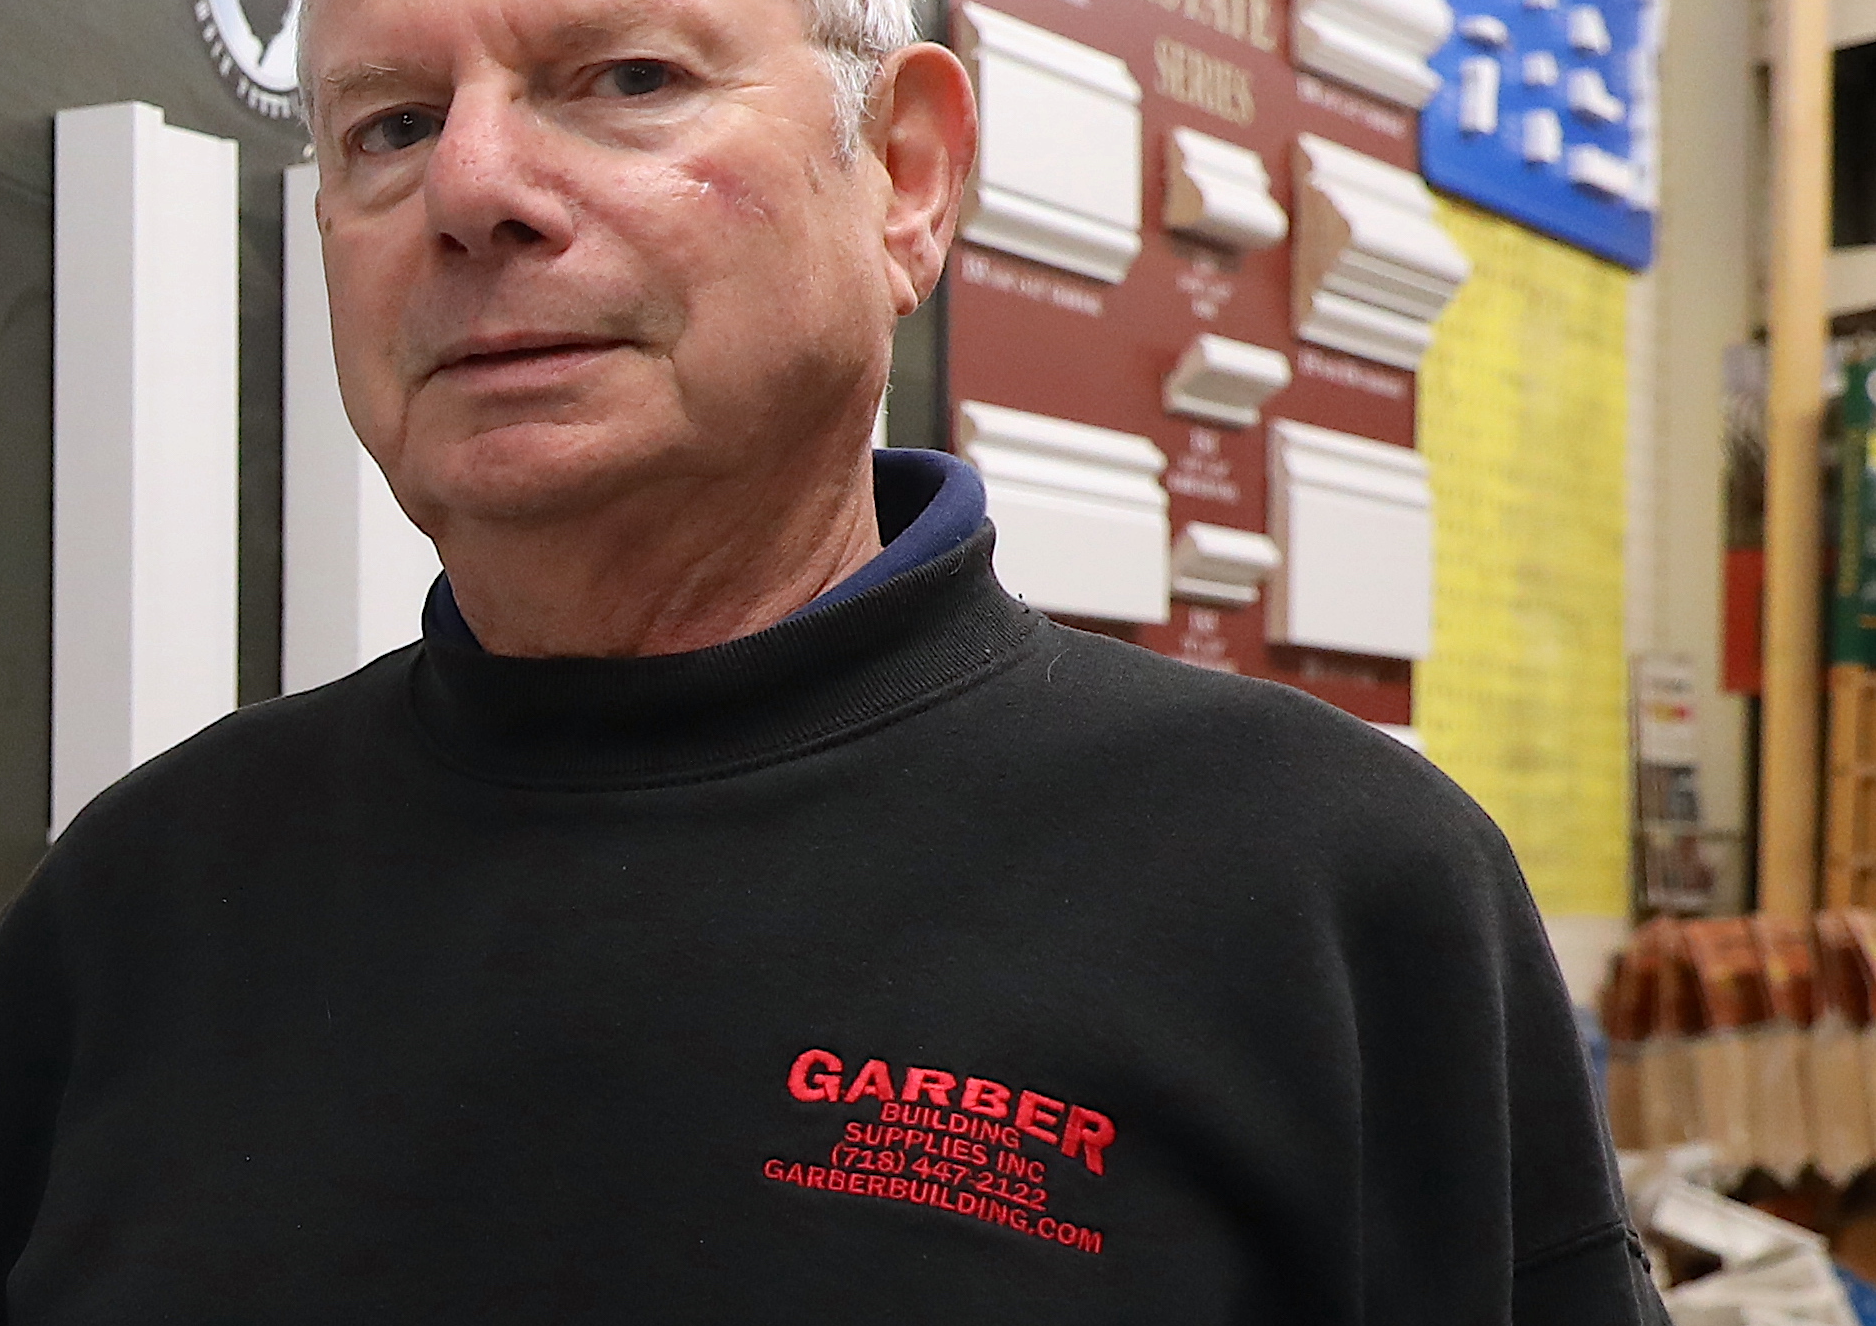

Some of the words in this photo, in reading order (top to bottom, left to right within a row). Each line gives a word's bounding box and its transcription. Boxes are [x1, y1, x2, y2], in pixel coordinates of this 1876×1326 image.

[787, 1048, 1116, 1175] GARBER
[880, 1101, 1021, 1149] BUILDING
[829, 1141, 906, 1173] (718)
[844, 1121, 989, 1166] SUPPLIES
[995, 1151, 1046, 1183] INC
[763, 1158, 1103, 1254] GARBERBUILDING.COM
